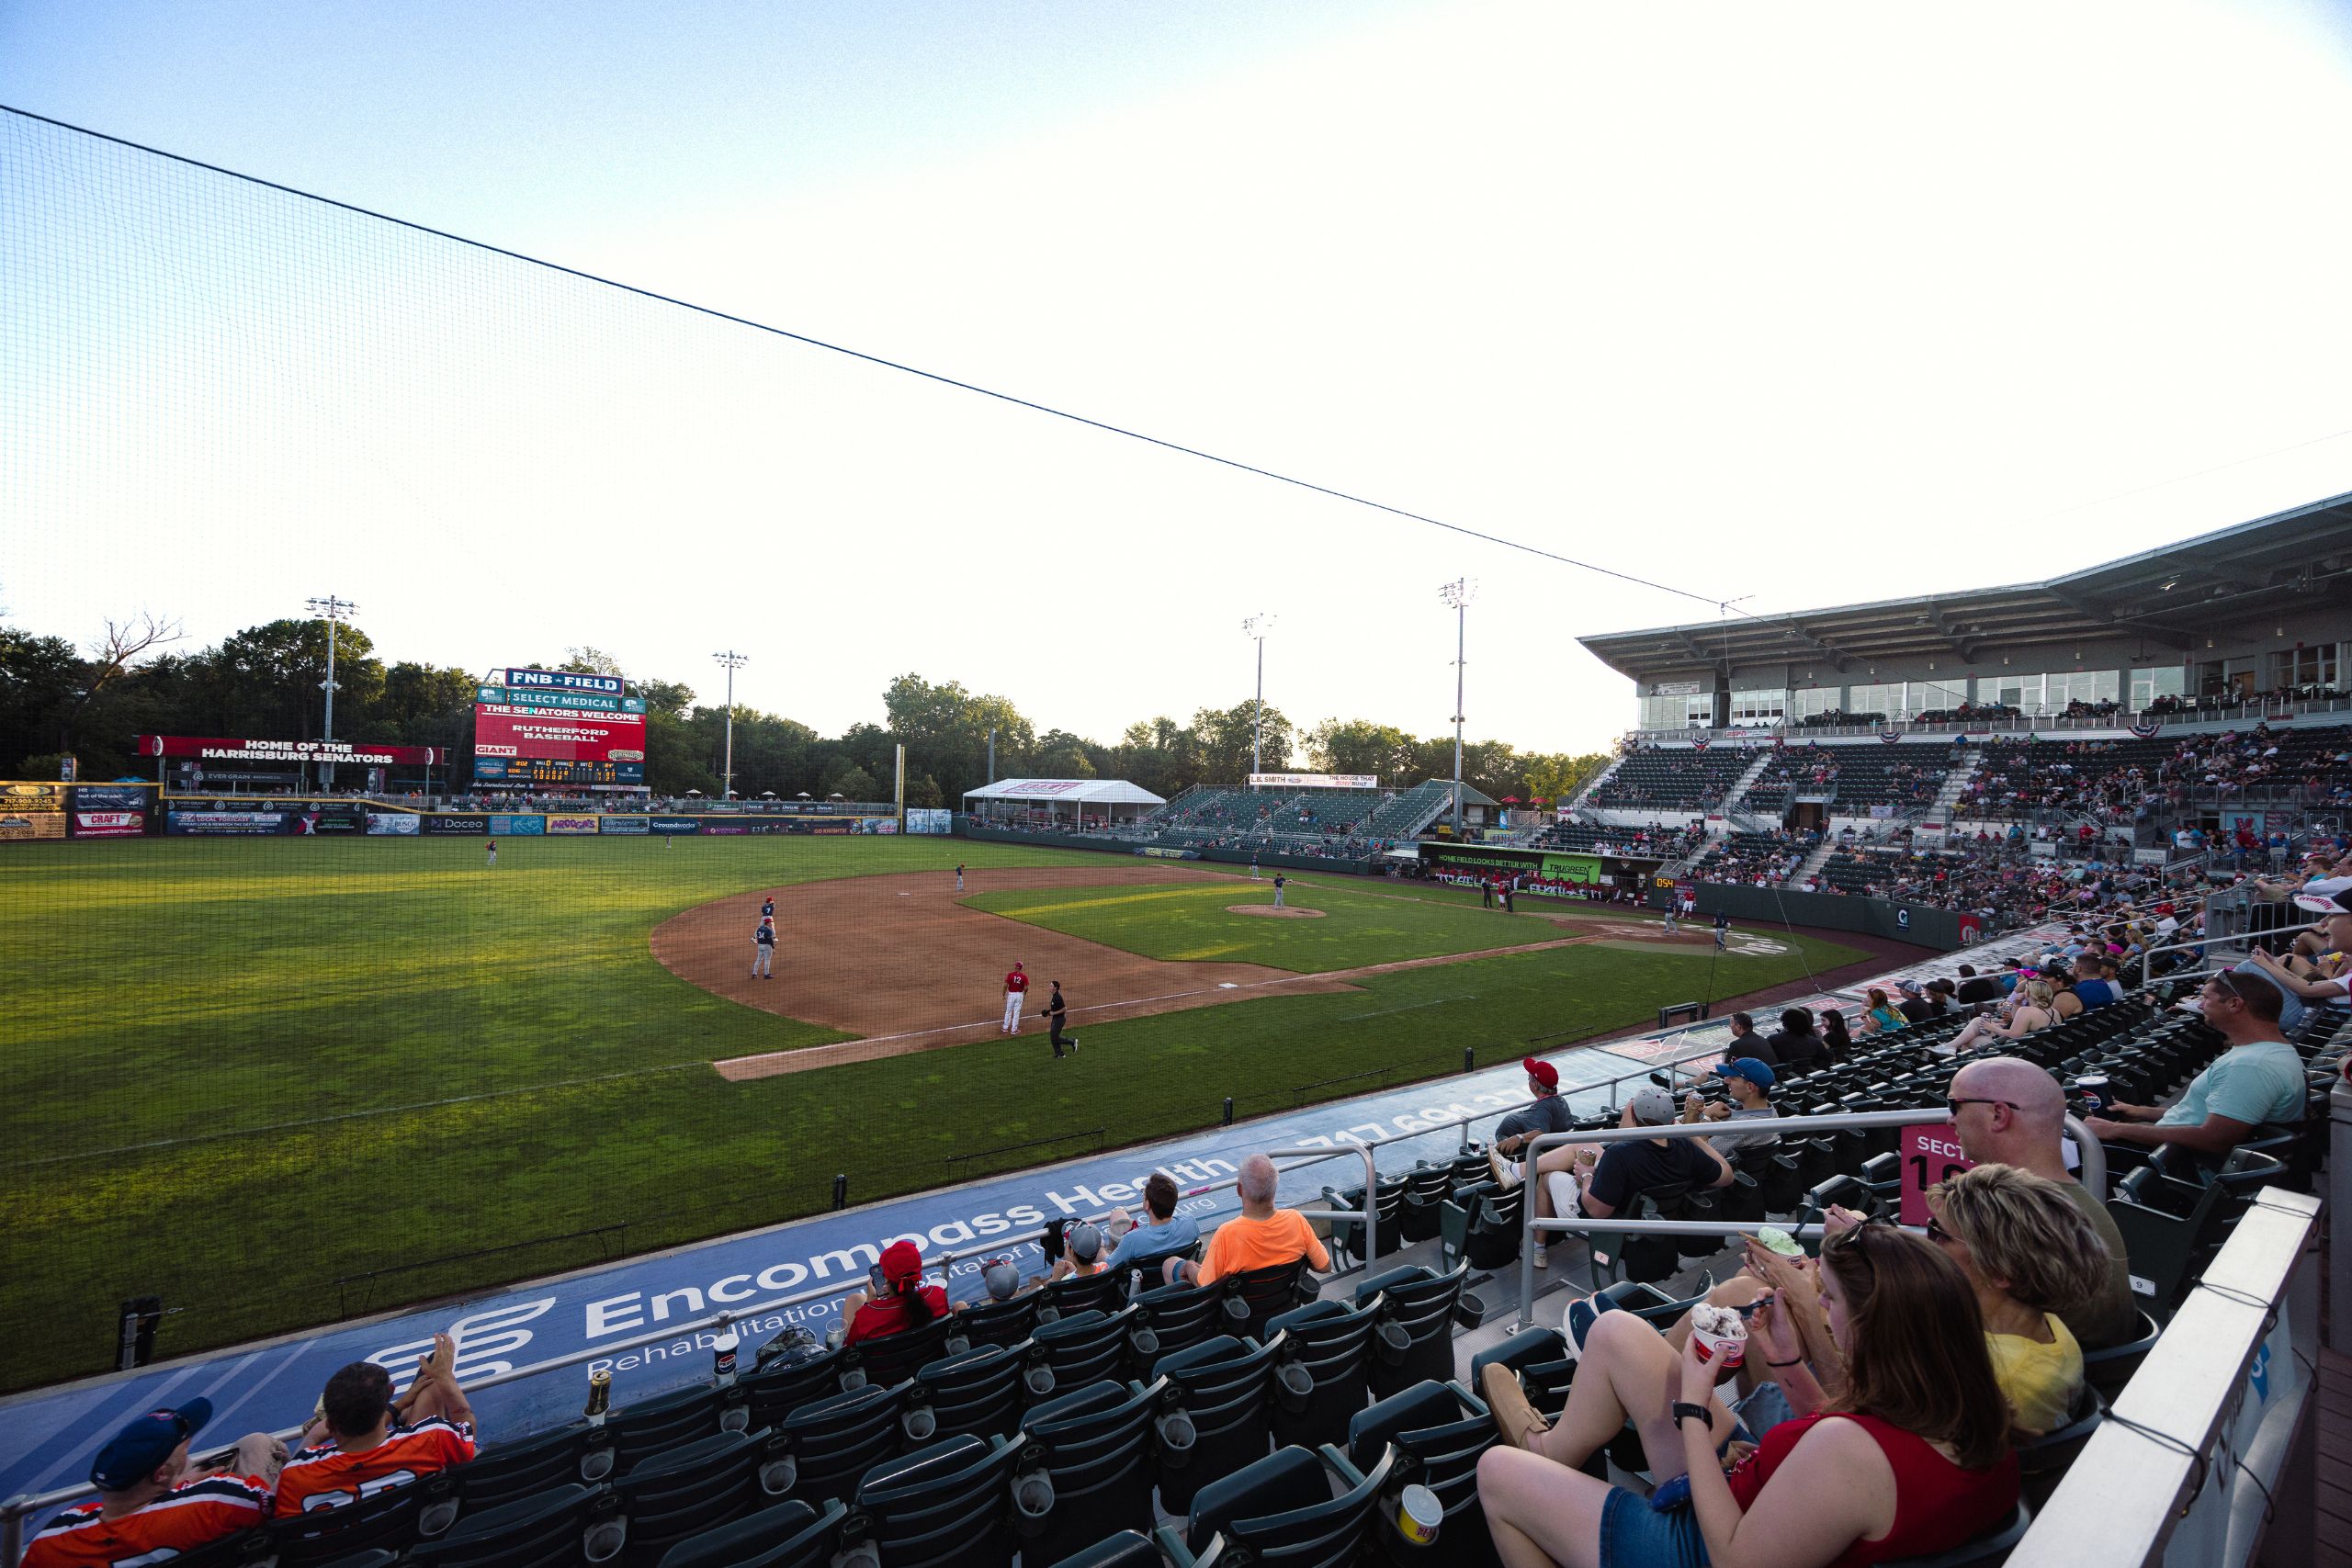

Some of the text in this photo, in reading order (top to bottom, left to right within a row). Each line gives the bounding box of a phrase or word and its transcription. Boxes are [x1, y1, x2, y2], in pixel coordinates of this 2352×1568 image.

[513, 672, 617, 691] FNB FIELD
[514, 694, 559, 705] SELECT
[561, 696, 616, 708] MEDICAL
[485, 705, 639, 721] THE SENATORS WELCOME
[513, 725, 609, 736] RUTHERFORD
[524, 733, 599, 742] BASEBALL
[245, 740, 352, 753] HOME OF THE
[476, 746, 515, 755] GIANT
[202, 749, 393, 763] HARRISBURG SENATORS
[91, 815, 121, 824] CRAFT
[445, 818, 483, 829] Doceo
[1495, 860, 1520, 868] BETTER
[1520, 862, 1538, 870] WITH
[1549, 863, 1589, 874] TRUGREEN
[1013, 976, 1022, 984] 12
[1295, 1122, 1392, 1159] 717
[1917, 1135, 1974, 1163] SECT
[586, 1246, 1024, 1381] Rehablitation of
